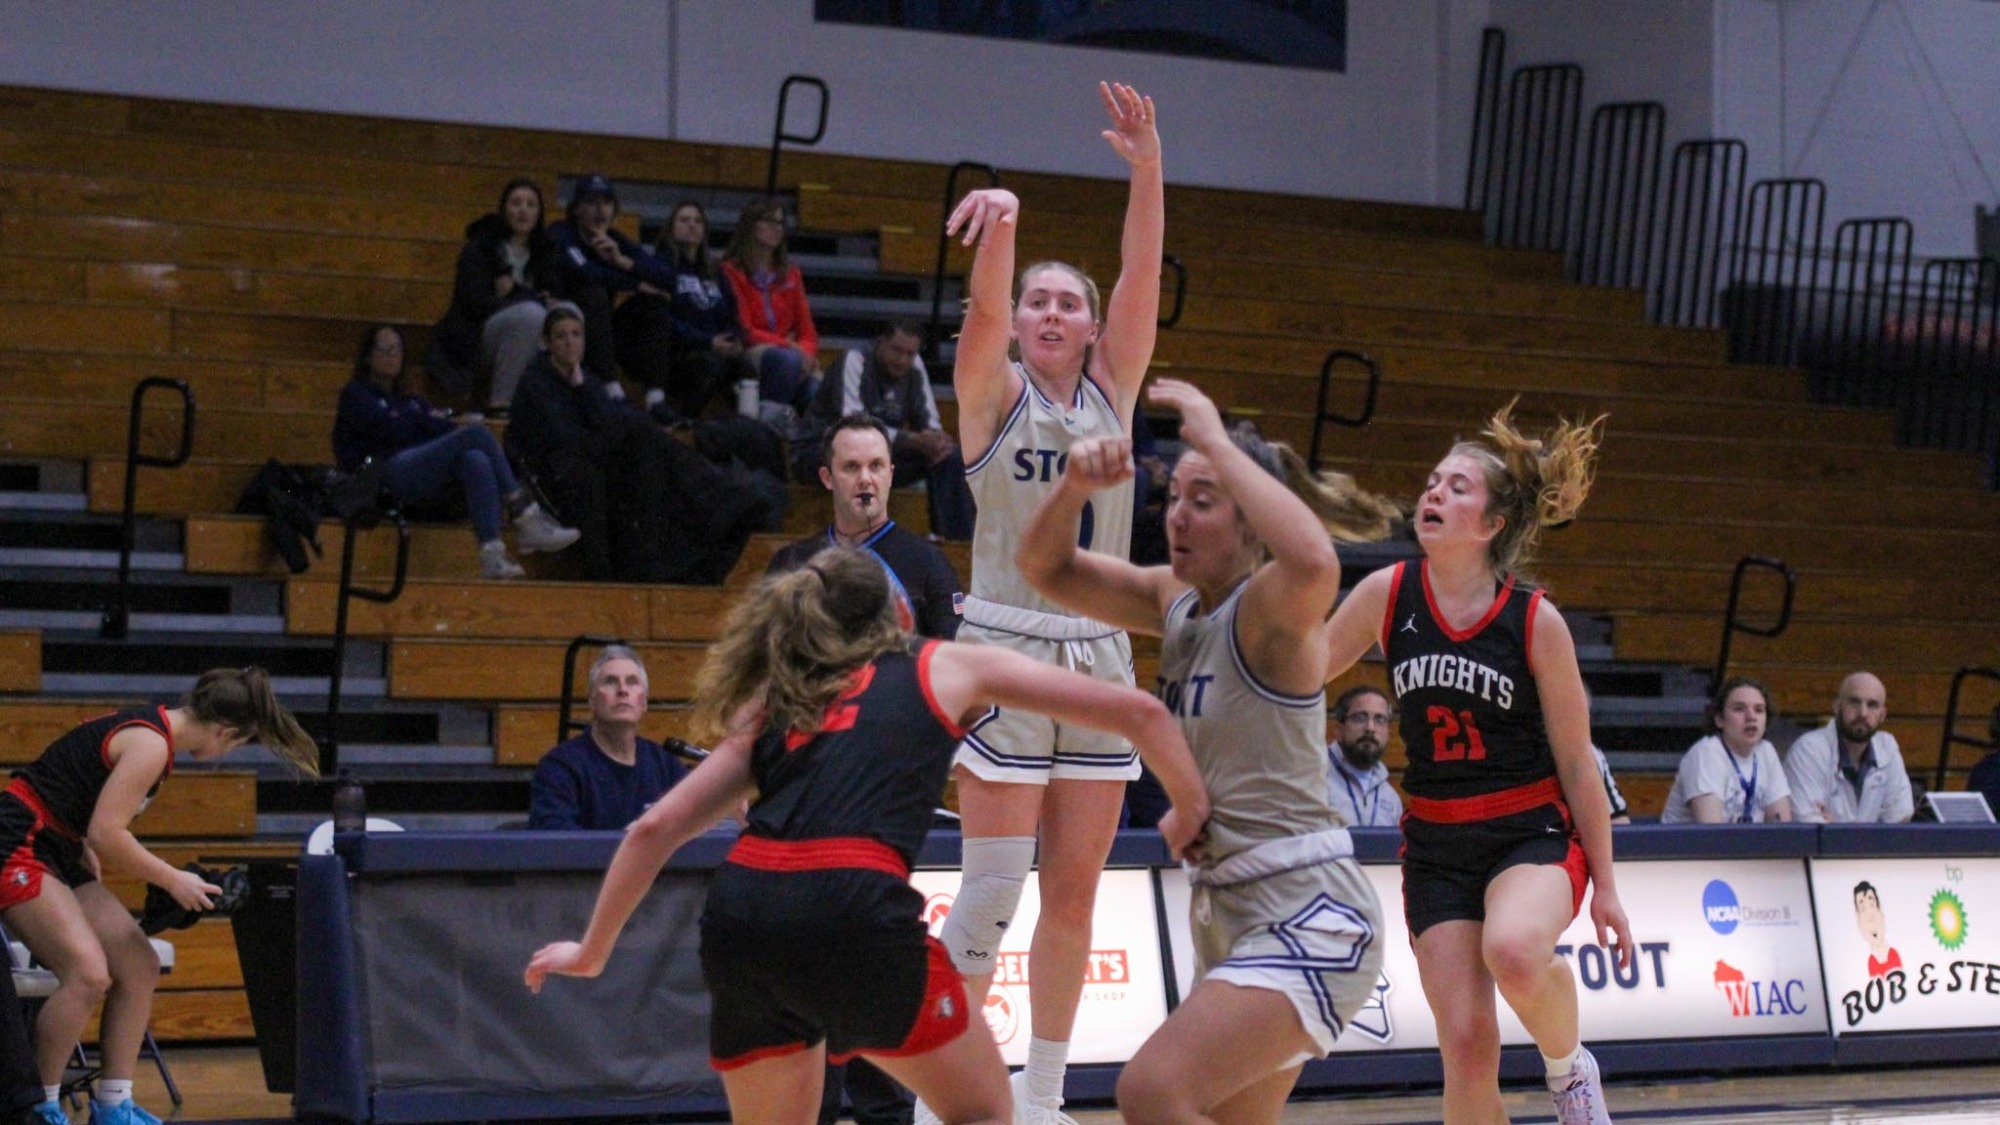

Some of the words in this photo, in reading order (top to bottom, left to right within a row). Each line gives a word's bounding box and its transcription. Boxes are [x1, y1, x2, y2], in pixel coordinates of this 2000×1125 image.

[1393, 654, 1514, 710] KNIGHTS
[1426, 705, 1487, 761] 21
[1945, 864, 1963, 883] bp
[1706, 905, 1740, 922] NCAA
[1715, 979, 1808, 1017] WIAC
[1842, 970, 1907, 1026] BOB
[1917, 963, 1938, 995] &
